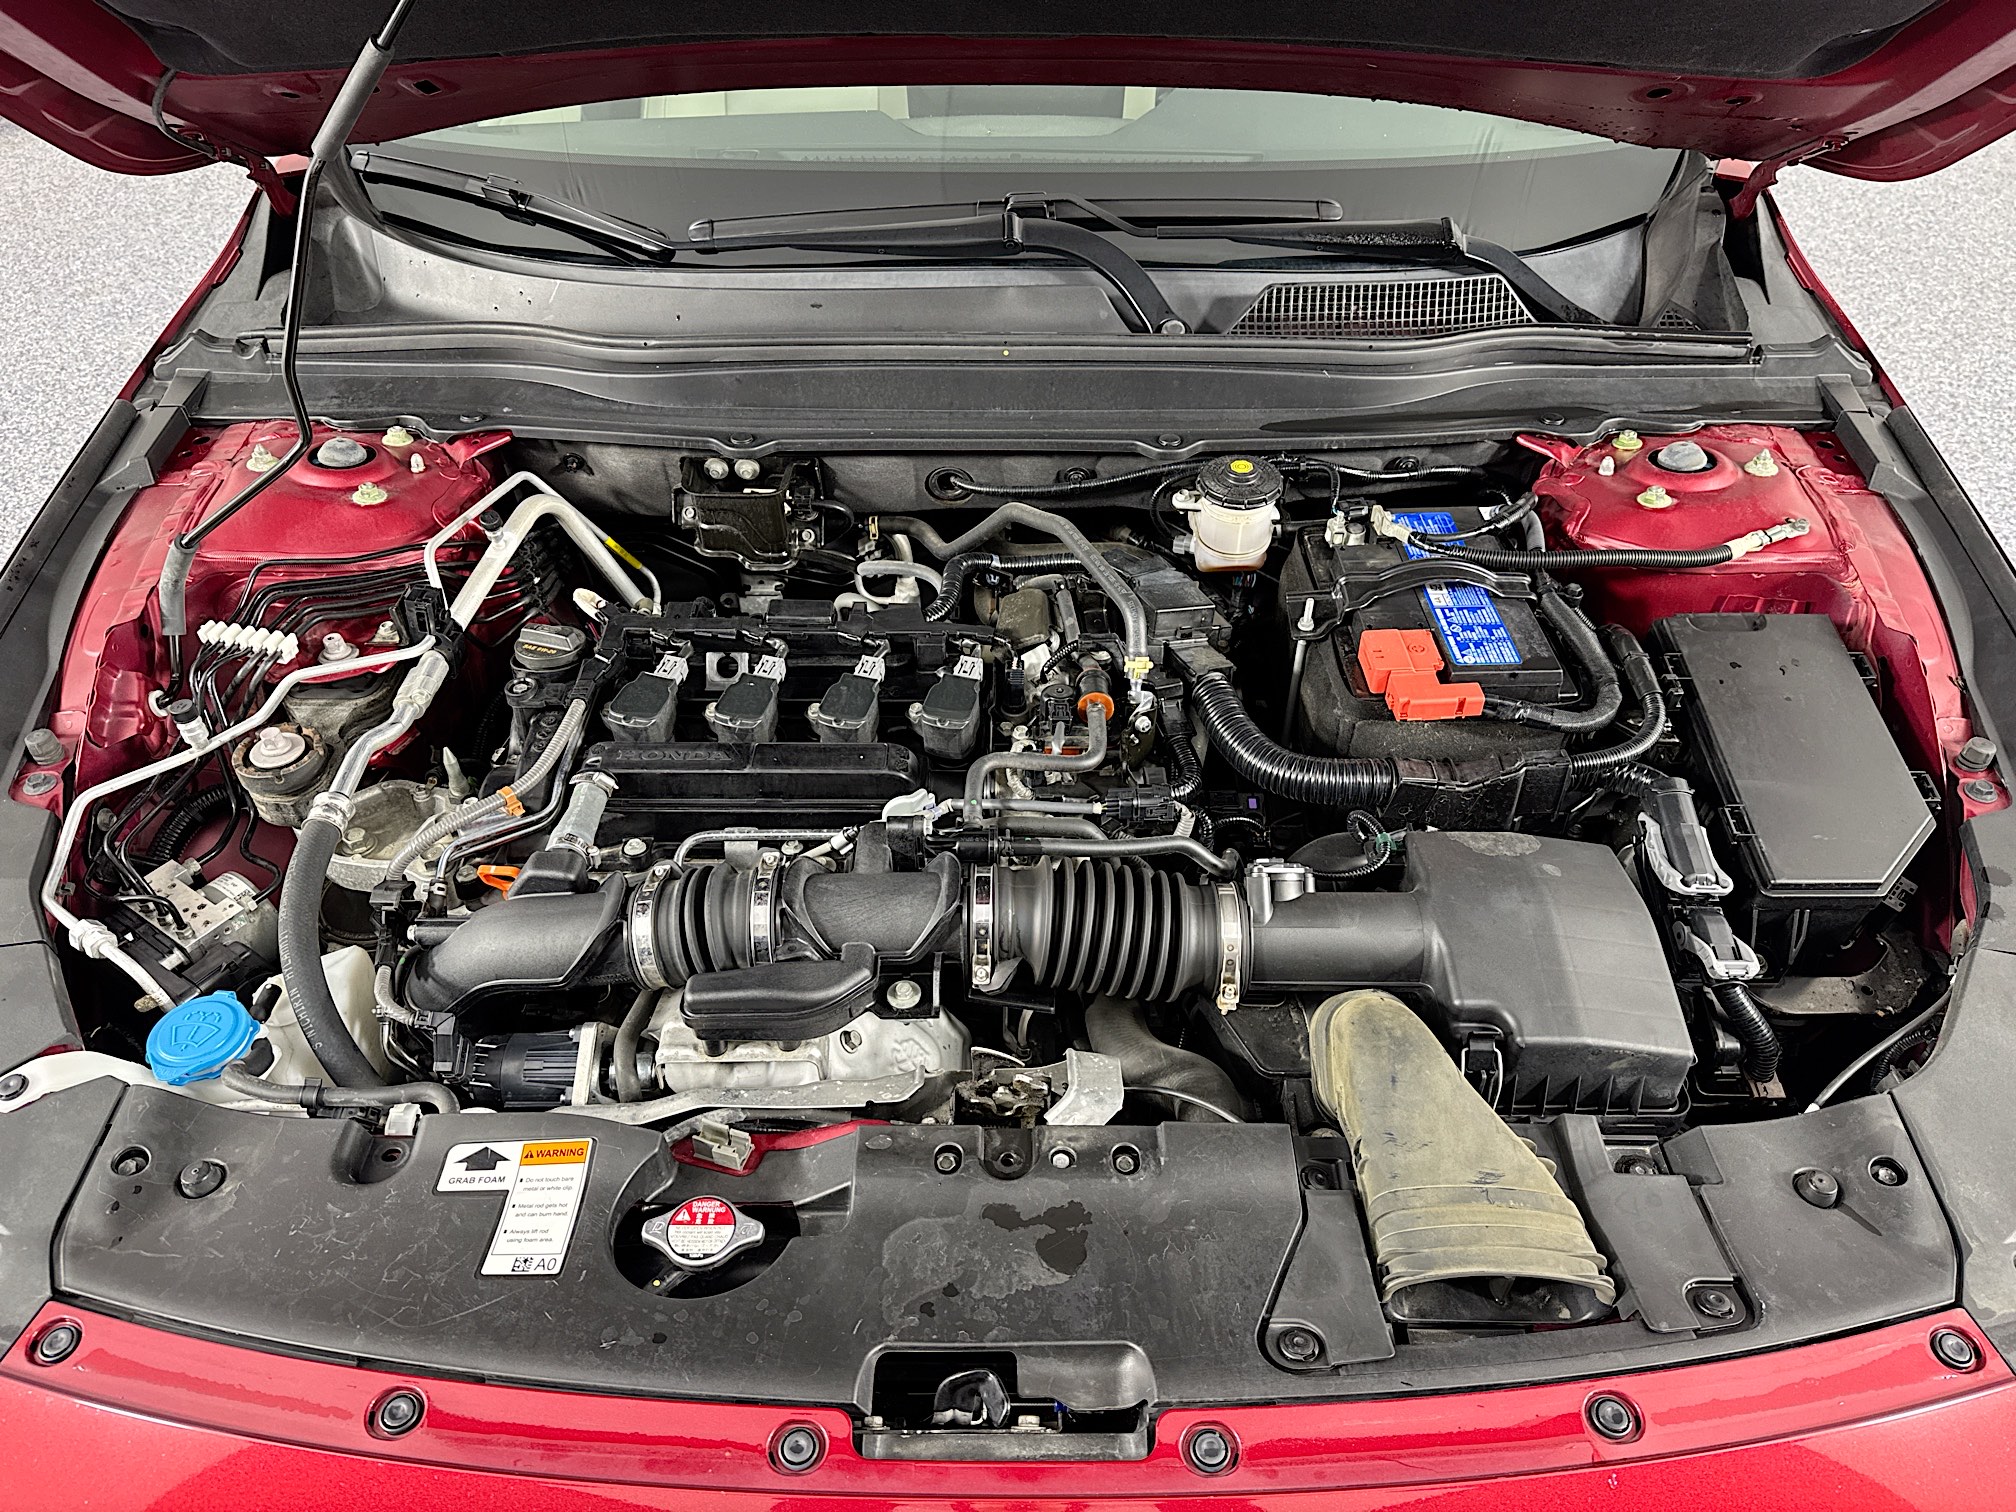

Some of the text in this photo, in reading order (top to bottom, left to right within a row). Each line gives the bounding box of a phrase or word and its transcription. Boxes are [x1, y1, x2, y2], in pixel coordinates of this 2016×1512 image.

[616, 749, 732, 761] HONDA
[289, 987, 317, 1039] NICHIRIN
[536, 1147, 585, 1158] WARNING
[448, 1175, 506, 1185] GRAB FOAM
[534, 1257, 557, 1271] A0
